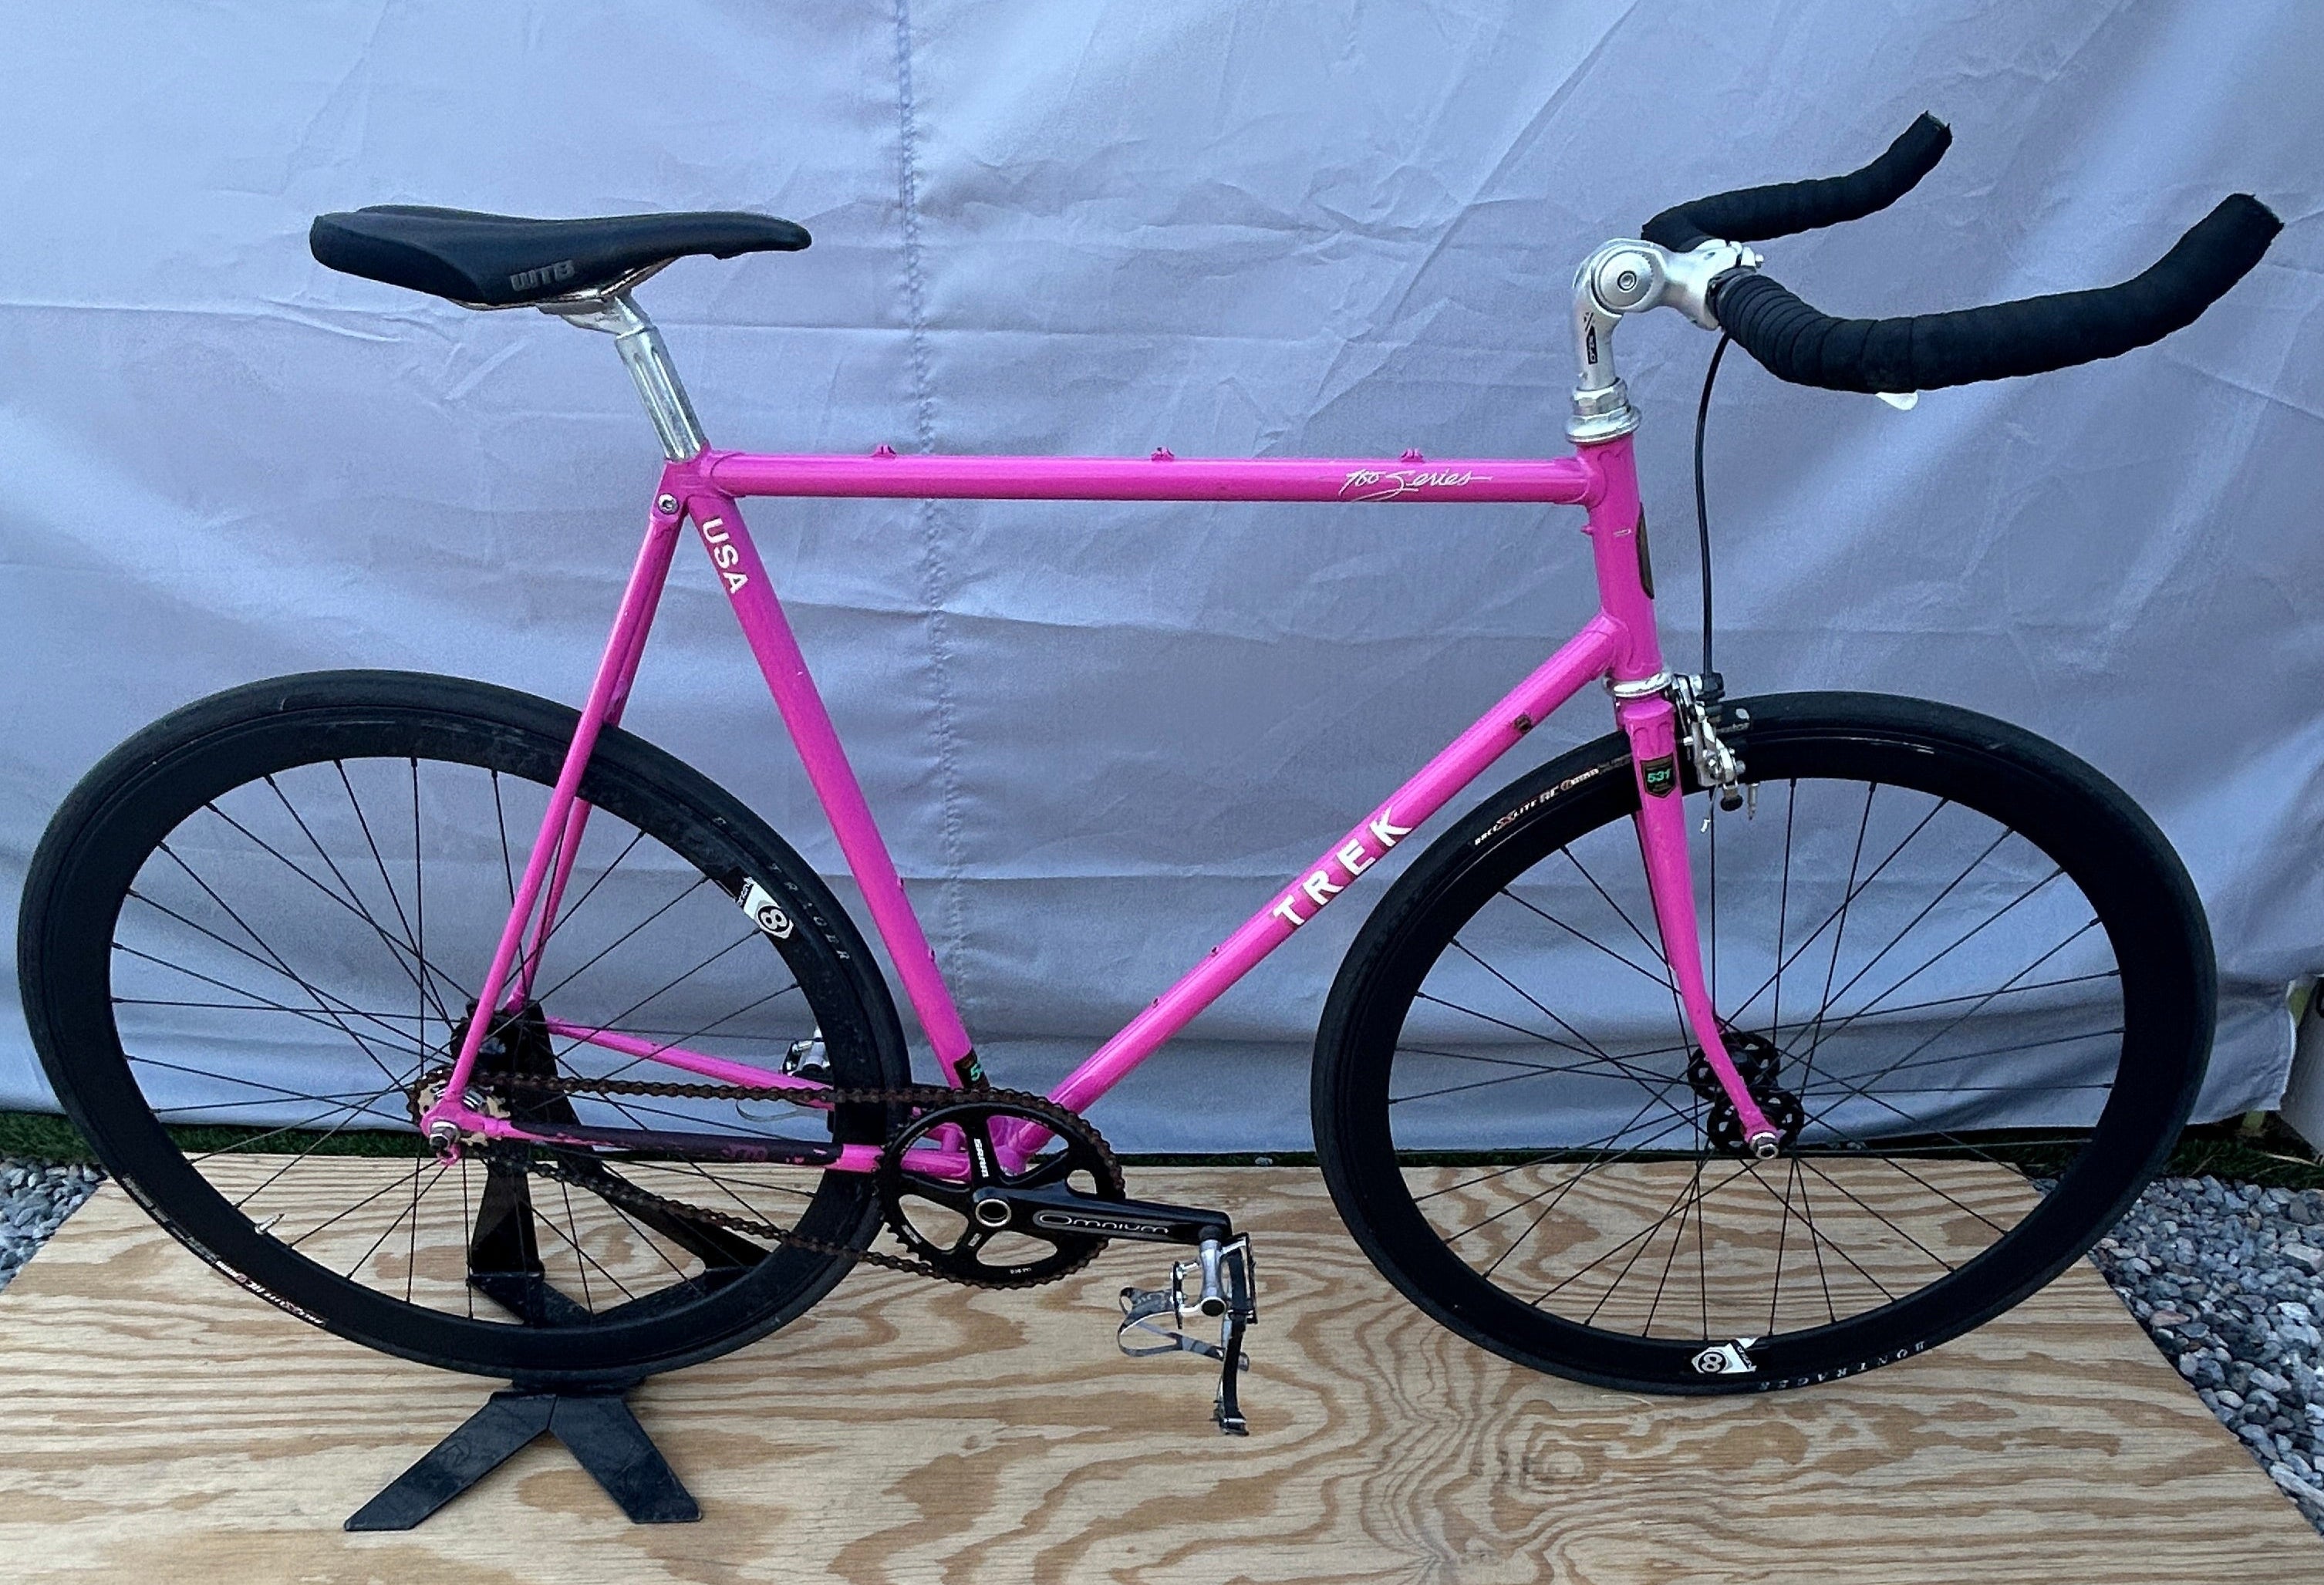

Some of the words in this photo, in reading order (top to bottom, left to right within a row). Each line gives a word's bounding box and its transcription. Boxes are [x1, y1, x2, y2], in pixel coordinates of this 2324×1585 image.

[509, 258, 576, 292] WTB
[1354, 467, 1493, 502] Series
[701, 518, 750, 595] USA
[1646, 768, 1672, 784] 531
[1272, 806, 1413, 926] TREK
